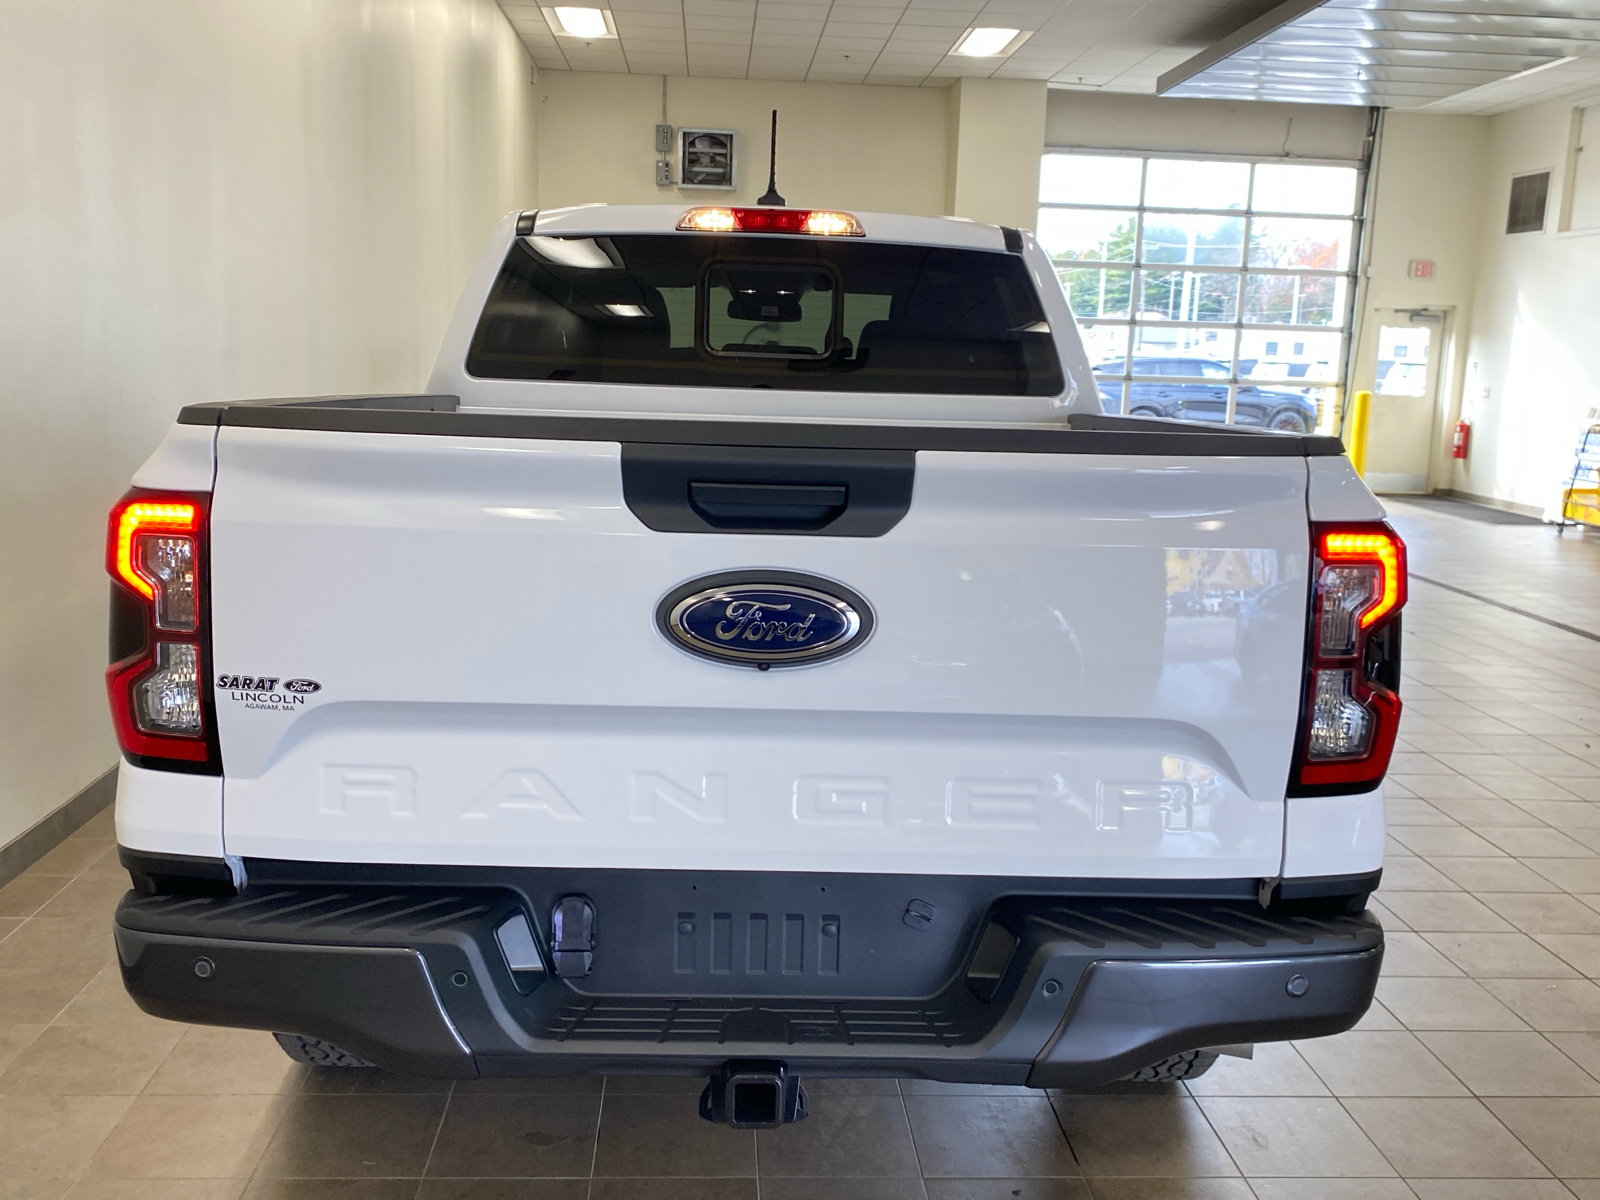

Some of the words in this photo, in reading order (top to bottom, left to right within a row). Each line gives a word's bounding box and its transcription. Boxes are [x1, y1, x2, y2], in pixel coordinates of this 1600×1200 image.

[1414, 261, 1435, 278] EXIT
[715, 600, 815, 642] Ford
[217, 674, 279, 692] SARAT
[290, 681, 316, 692] Ford
[231, 691, 304, 704] LINCOLN
[245, 703, 281, 711] AGAWAM,
[318, 763, 1196, 832] RANGER
